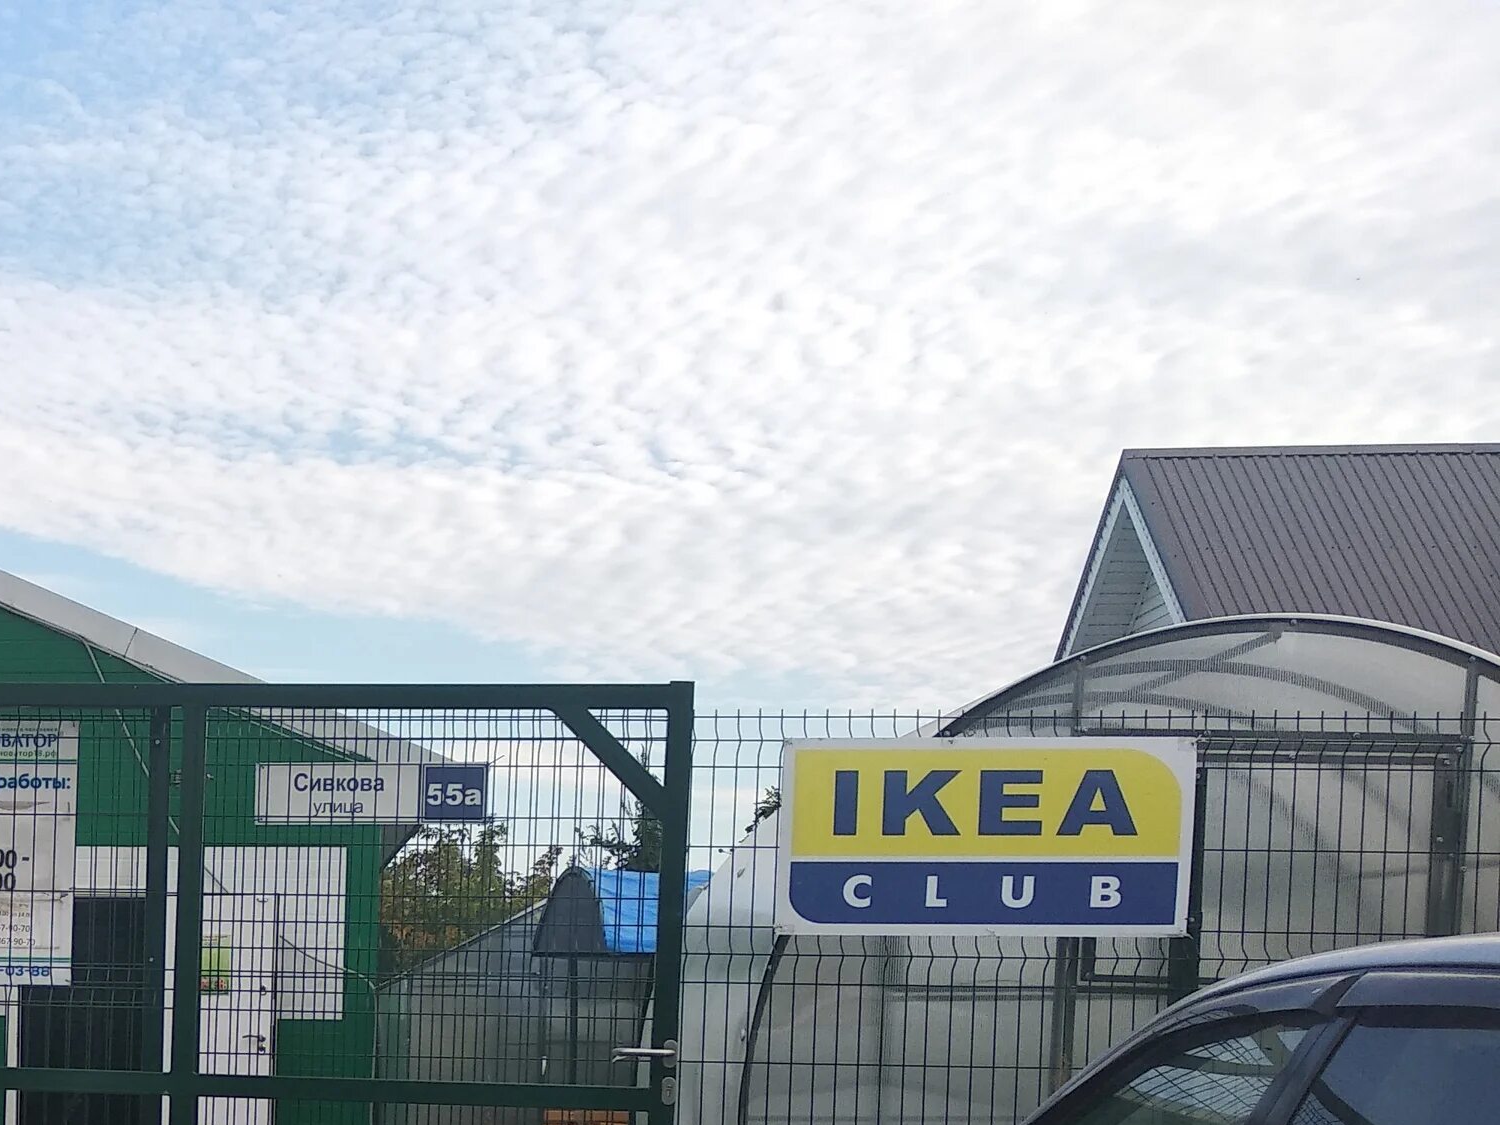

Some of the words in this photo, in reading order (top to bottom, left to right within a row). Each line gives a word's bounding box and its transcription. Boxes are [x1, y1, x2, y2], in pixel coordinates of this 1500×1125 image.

[293, 772, 385, 793] Сивкова
[426, 783, 482, 806] 55а
[833, 769, 1138, 837] IKEA
[313, 801, 364, 817] улица
[842, 874, 1122, 909] CLUB
